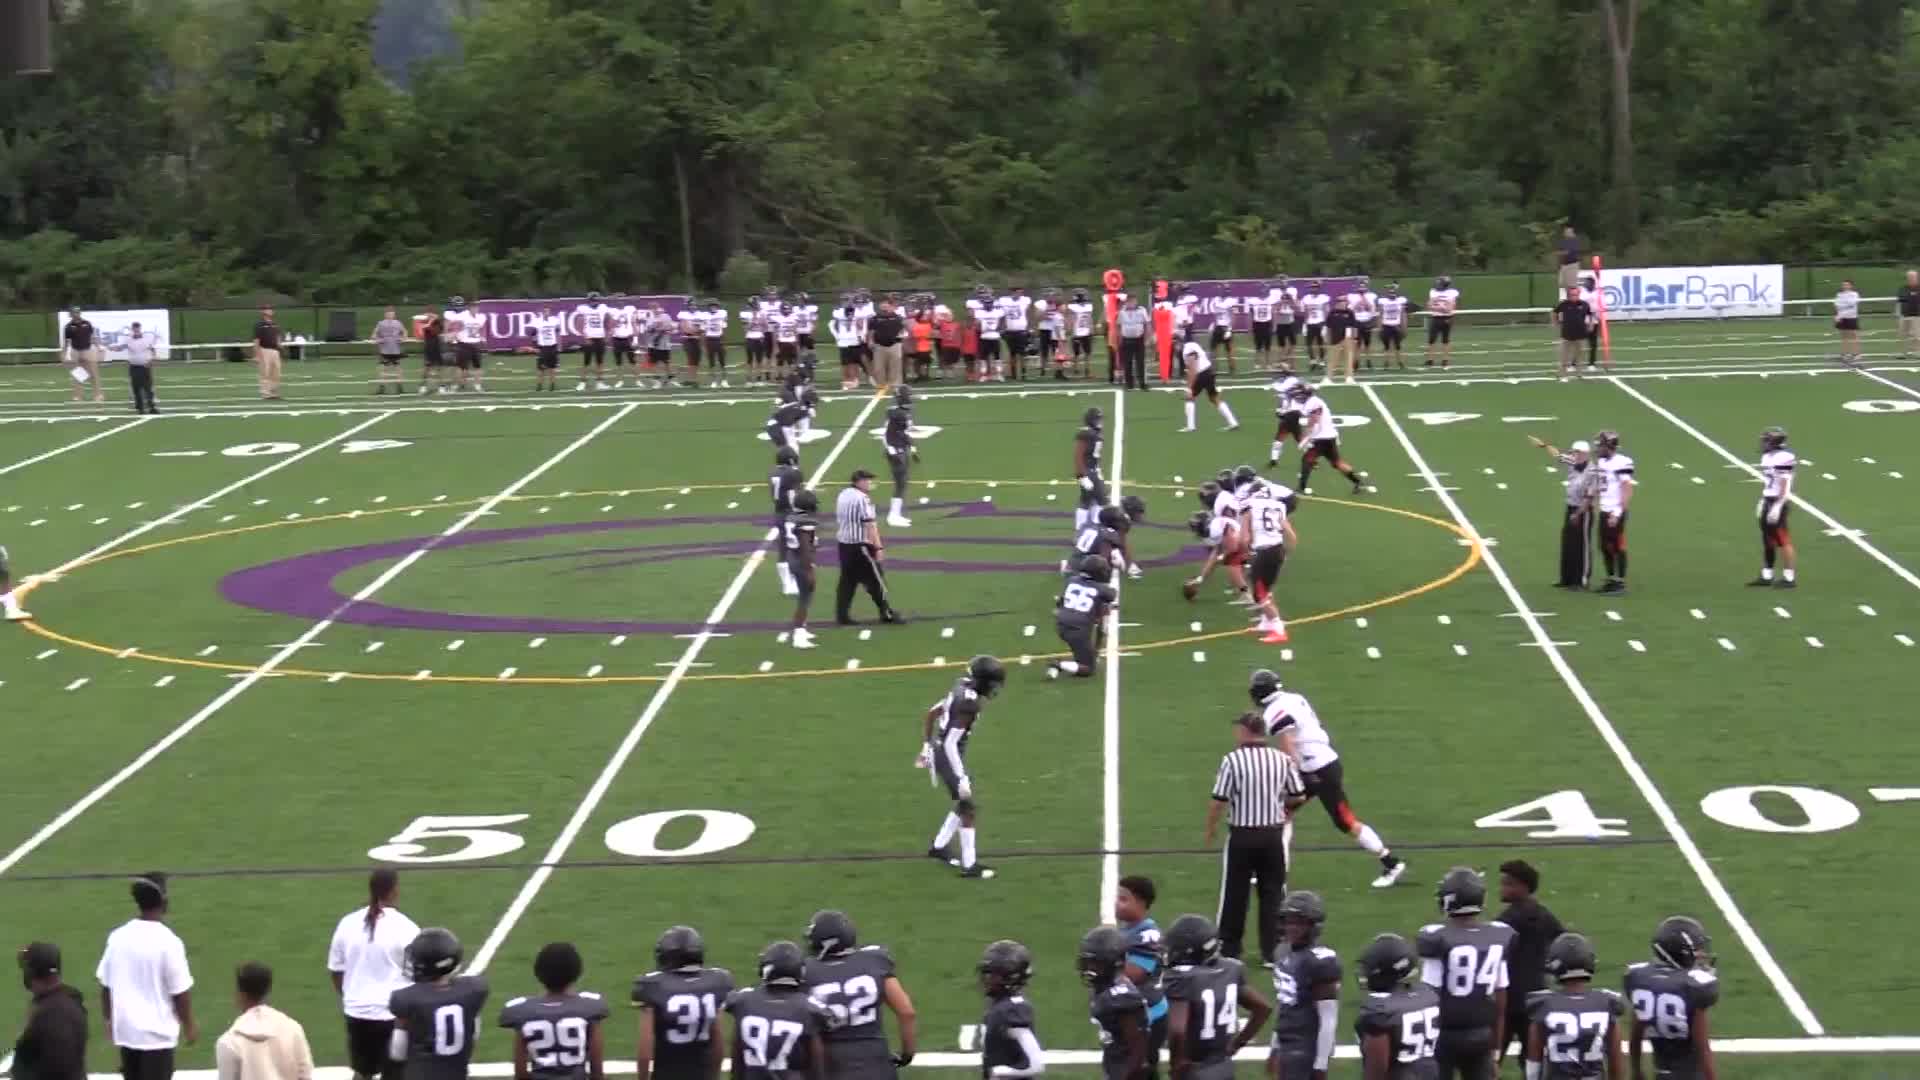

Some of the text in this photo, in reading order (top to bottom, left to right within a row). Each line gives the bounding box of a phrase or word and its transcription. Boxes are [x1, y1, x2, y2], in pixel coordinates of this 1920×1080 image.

[1603, 273, 1772, 310] ollarBank
[1446, 944, 1506, 997] 84
[433, 1003, 465, 1057] 0
[666, 993, 717, 1044] 31
[1200, 983, 1238, 1040] 14
[1545, 1010, 1609, 1062] 27
[524, 1016, 588, 1067] 29
[740, 1015, 804, 1069] 97
